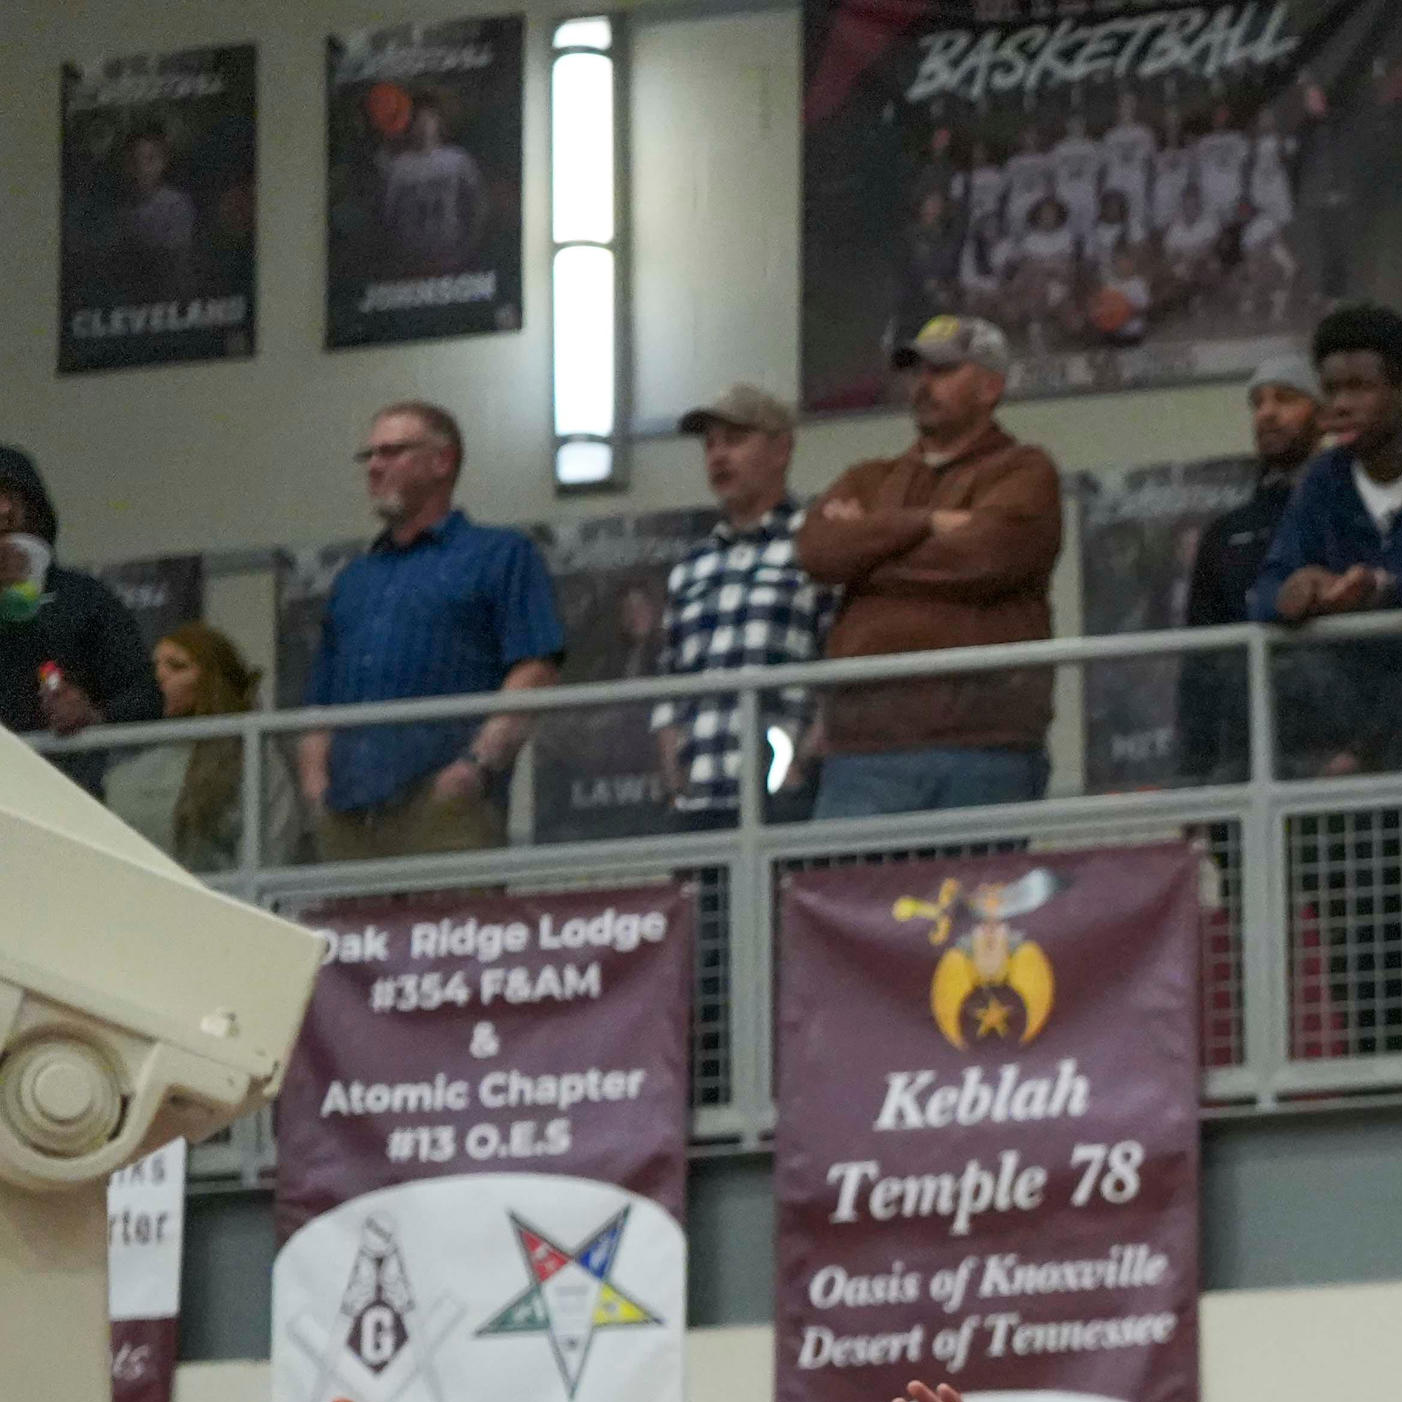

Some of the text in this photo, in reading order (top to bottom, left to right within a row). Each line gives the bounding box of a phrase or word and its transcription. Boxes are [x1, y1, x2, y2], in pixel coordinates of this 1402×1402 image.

[905, 2, 1301, 101] BASKETBALL
[72, 296, 246, 338] CLEVELAND
[410, 917, 529, 962] Ridge
[539, 907, 668, 952] Lodge
[370, 961, 601, 1014] #354 F&AM
[469, 1020, 500, 1059] &
[320, 1067, 646, 1118] Atomic Chapter
[873, 1057, 1091, 1132] Keblah
[386, 1125, 456, 1163] #13
[826, 1139, 1145, 1236] Temple 78
[809, 1243, 1170, 1314] Oasis of Knoxville
[798, 1311, 1180, 1374] Desert of Tennessee
